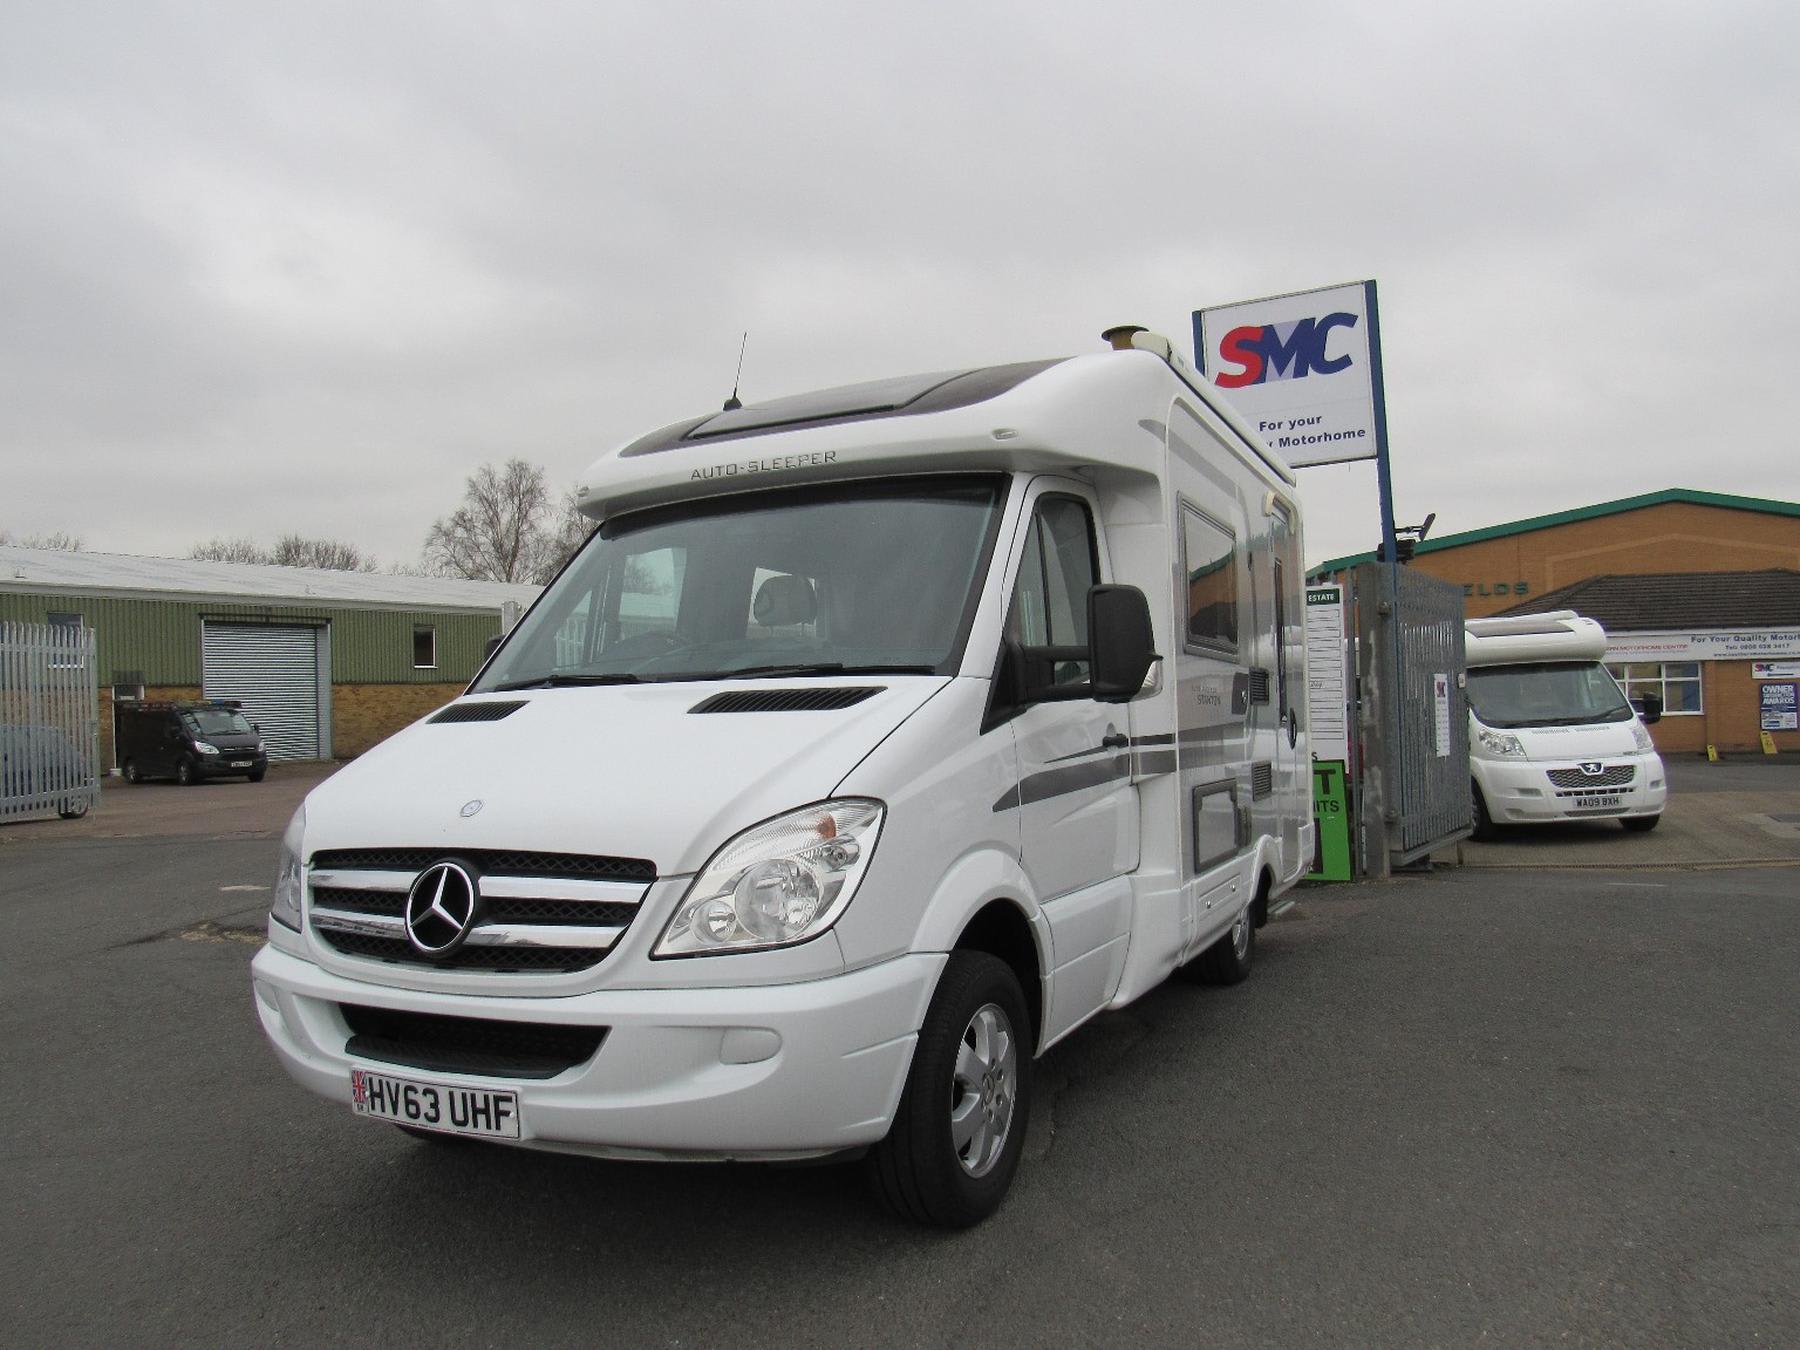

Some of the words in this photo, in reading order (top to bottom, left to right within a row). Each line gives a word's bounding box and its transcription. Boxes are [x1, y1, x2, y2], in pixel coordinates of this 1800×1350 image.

[1214, 312, 1358, 388] SMC
[1259, 420, 1283, 432] For
[1289, 415, 1322, 430] your
[1279, 429, 1366, 448] Motorhome
[690, 450, 837, 480] AUTO-SLEEPER
[1308, 594, 1334, 602] ESTATE
[1710, 635, 1730, 643] Your
[1733, 634, 1767, 643] Quality
[1762, 685, 1794, 694] OWNER
[369, 1077, 440, 1123] HV63
[449, 1091, 513, 1131] UHF
